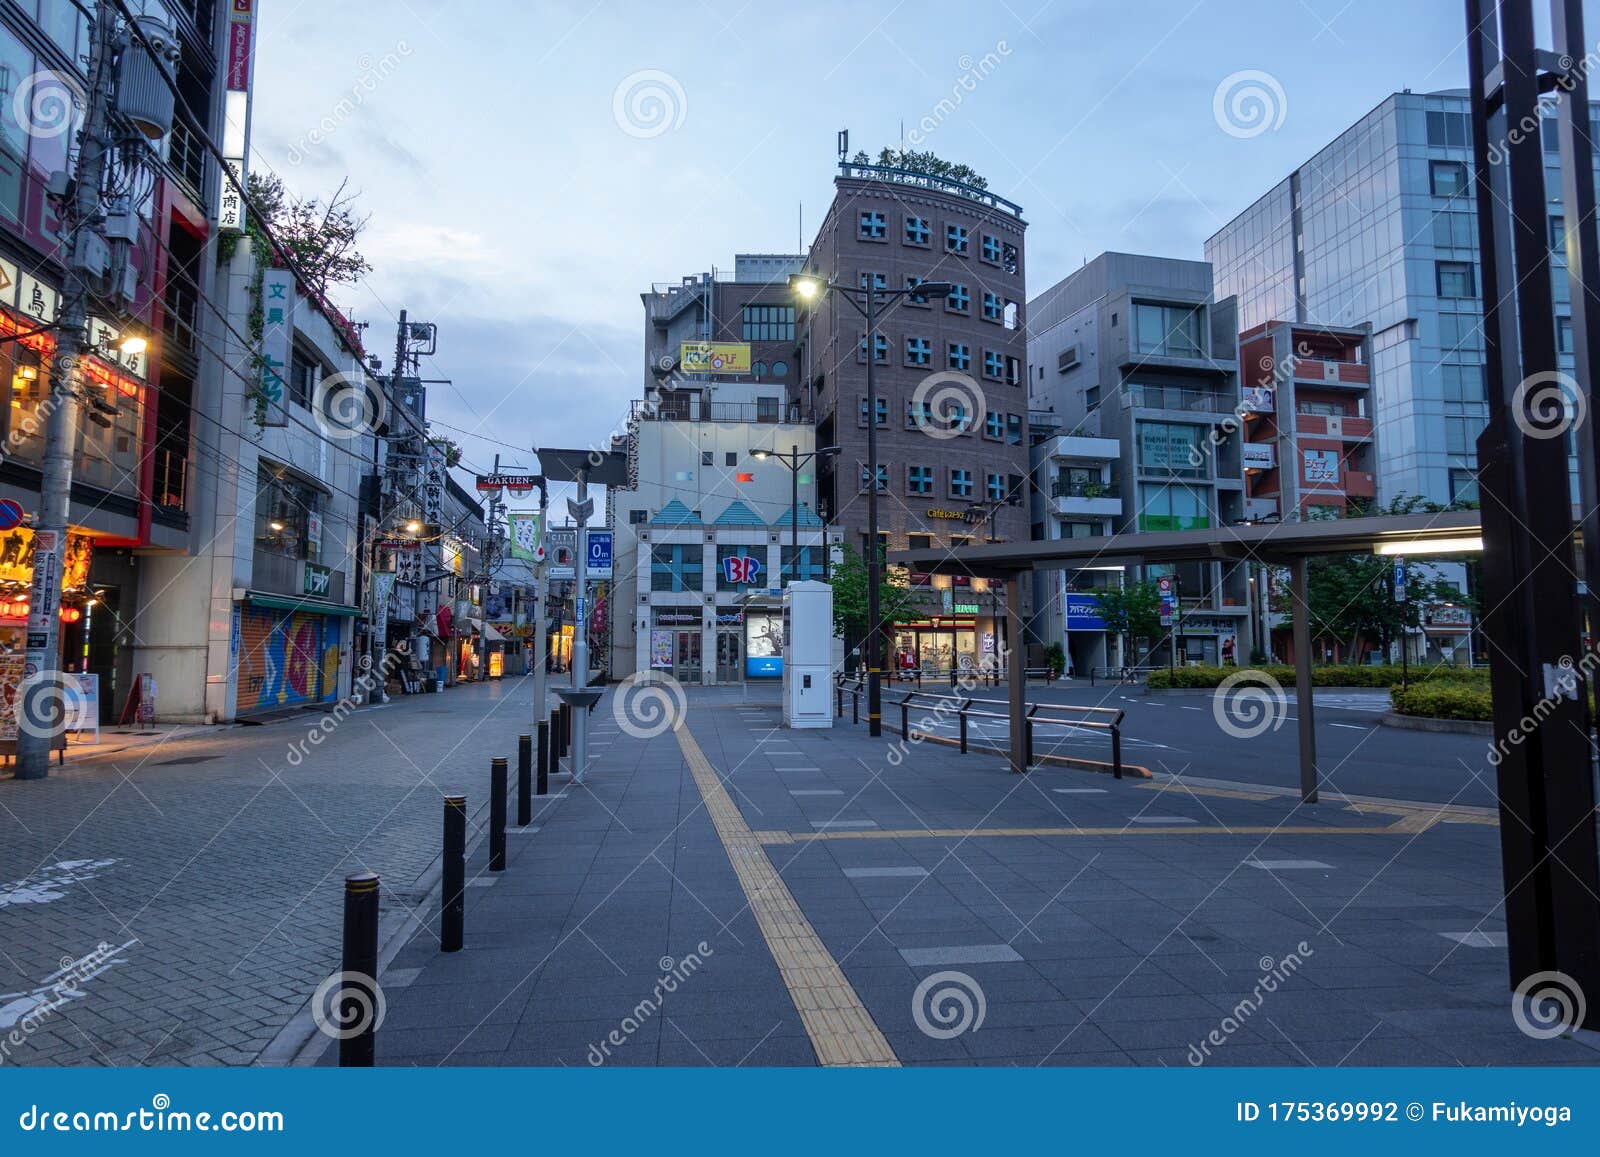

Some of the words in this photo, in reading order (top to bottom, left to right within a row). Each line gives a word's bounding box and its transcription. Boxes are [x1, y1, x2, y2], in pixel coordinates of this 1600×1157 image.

[267, 281, 287, 322] 文具
[722, 556, 760, 583] BR
[1396, 567, 1403, 579] P
